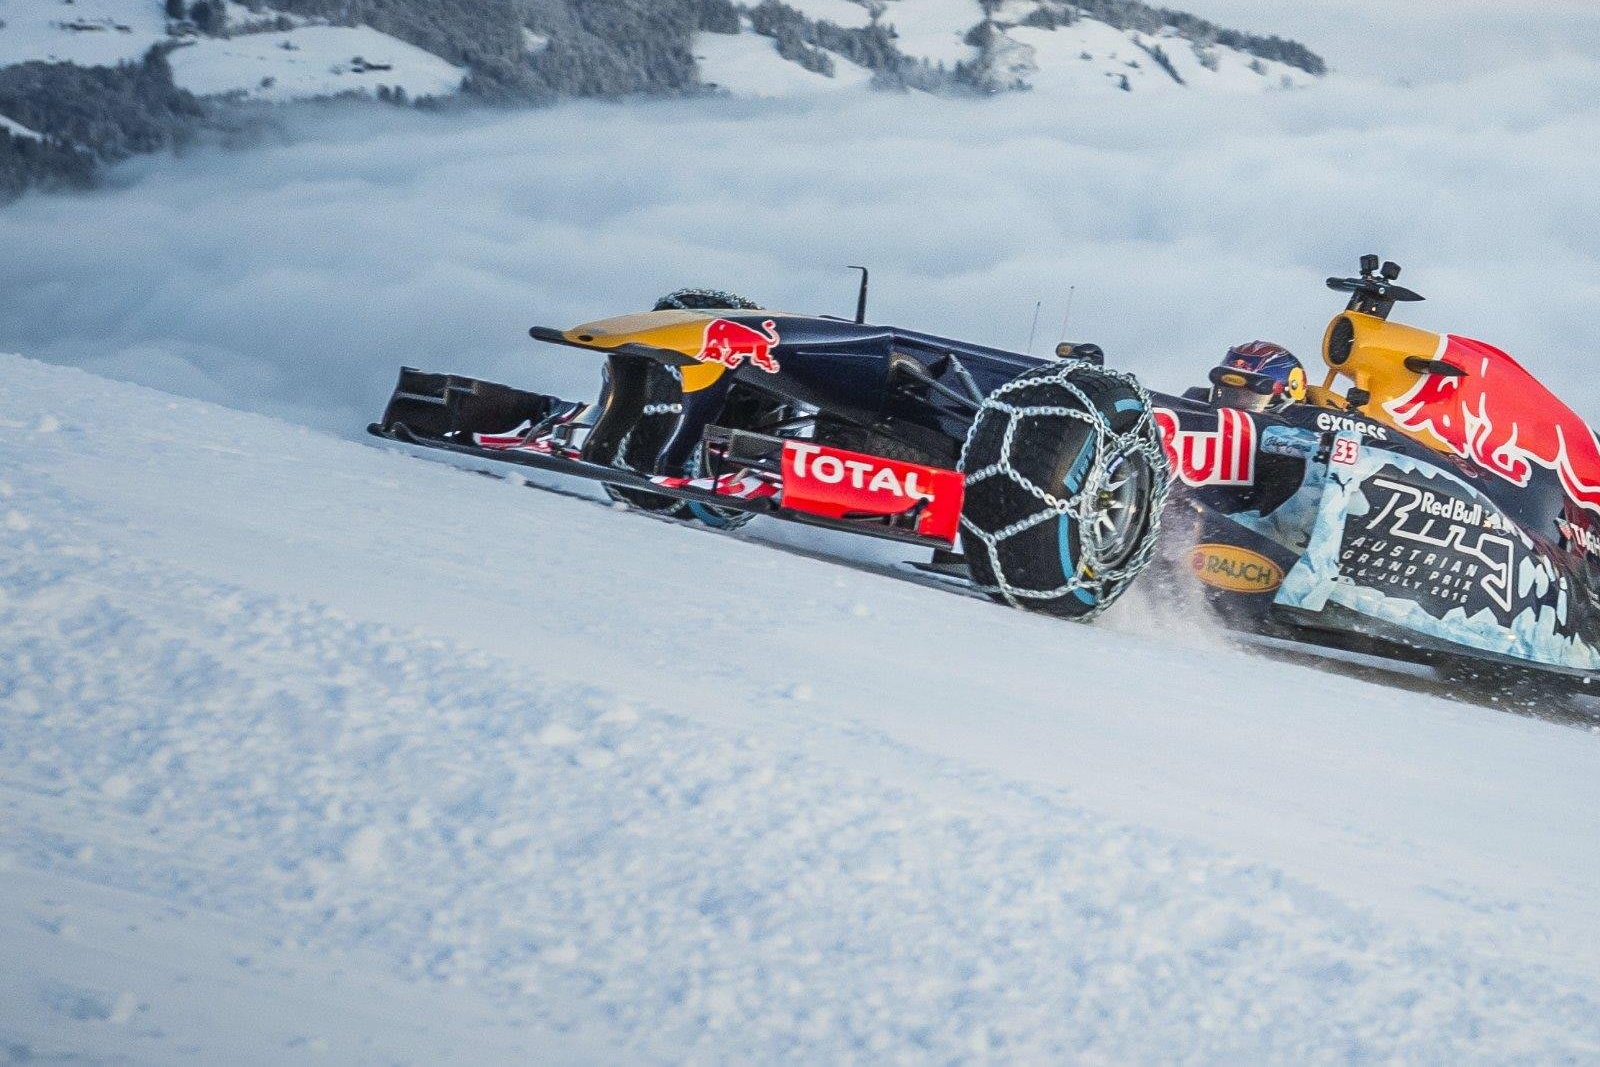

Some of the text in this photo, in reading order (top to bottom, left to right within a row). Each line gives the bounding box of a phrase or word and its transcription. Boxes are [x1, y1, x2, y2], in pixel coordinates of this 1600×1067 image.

[1317, 413, 1388, 441] exness
[1332, 439, 1359, 465] 33
[785, 440, 935, 502] TOTAL
[1420, 492, 1483, 526] Red Bull
[1206, 555, 1272, 585] RAUCH
[1342, 550, 1473, 592] GRAND PRIX
[1351, 536, 1479, 577] AUSTRIAN
[1377, 572, 1423, 590] JULY
[1431, 586, 1469, 604] 2016
